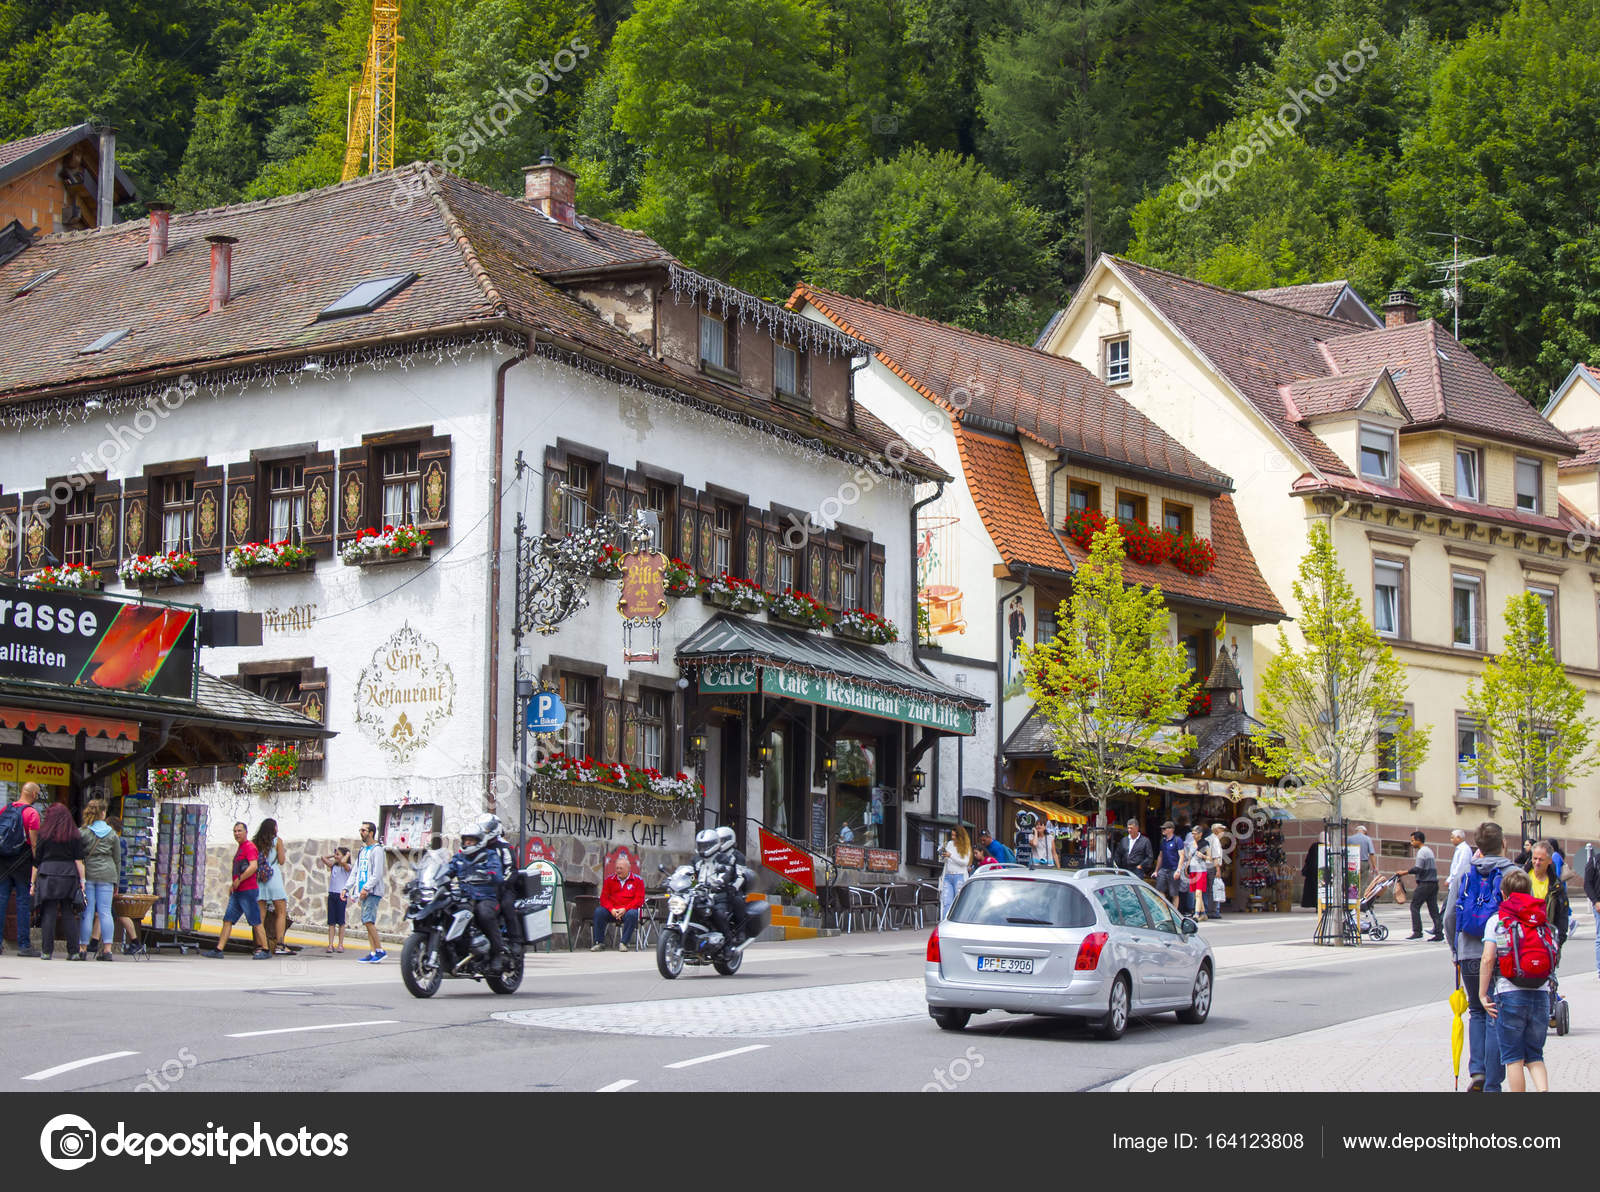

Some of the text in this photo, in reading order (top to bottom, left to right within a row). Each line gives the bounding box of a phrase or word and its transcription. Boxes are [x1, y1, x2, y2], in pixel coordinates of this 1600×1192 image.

[0, 599, 97, 636] rasse
[0, 643, 66, 668] alitäten
[539, 695, 552, 718] P
[825, 677, 899, 716] Restaurant
[0, 762, 13, 772] TO
[36, 766, 64, 777] LOTTO
[526, 808, 616, 840] RESTAURANT
[984, 958, 1032, 971] PF E 3906
